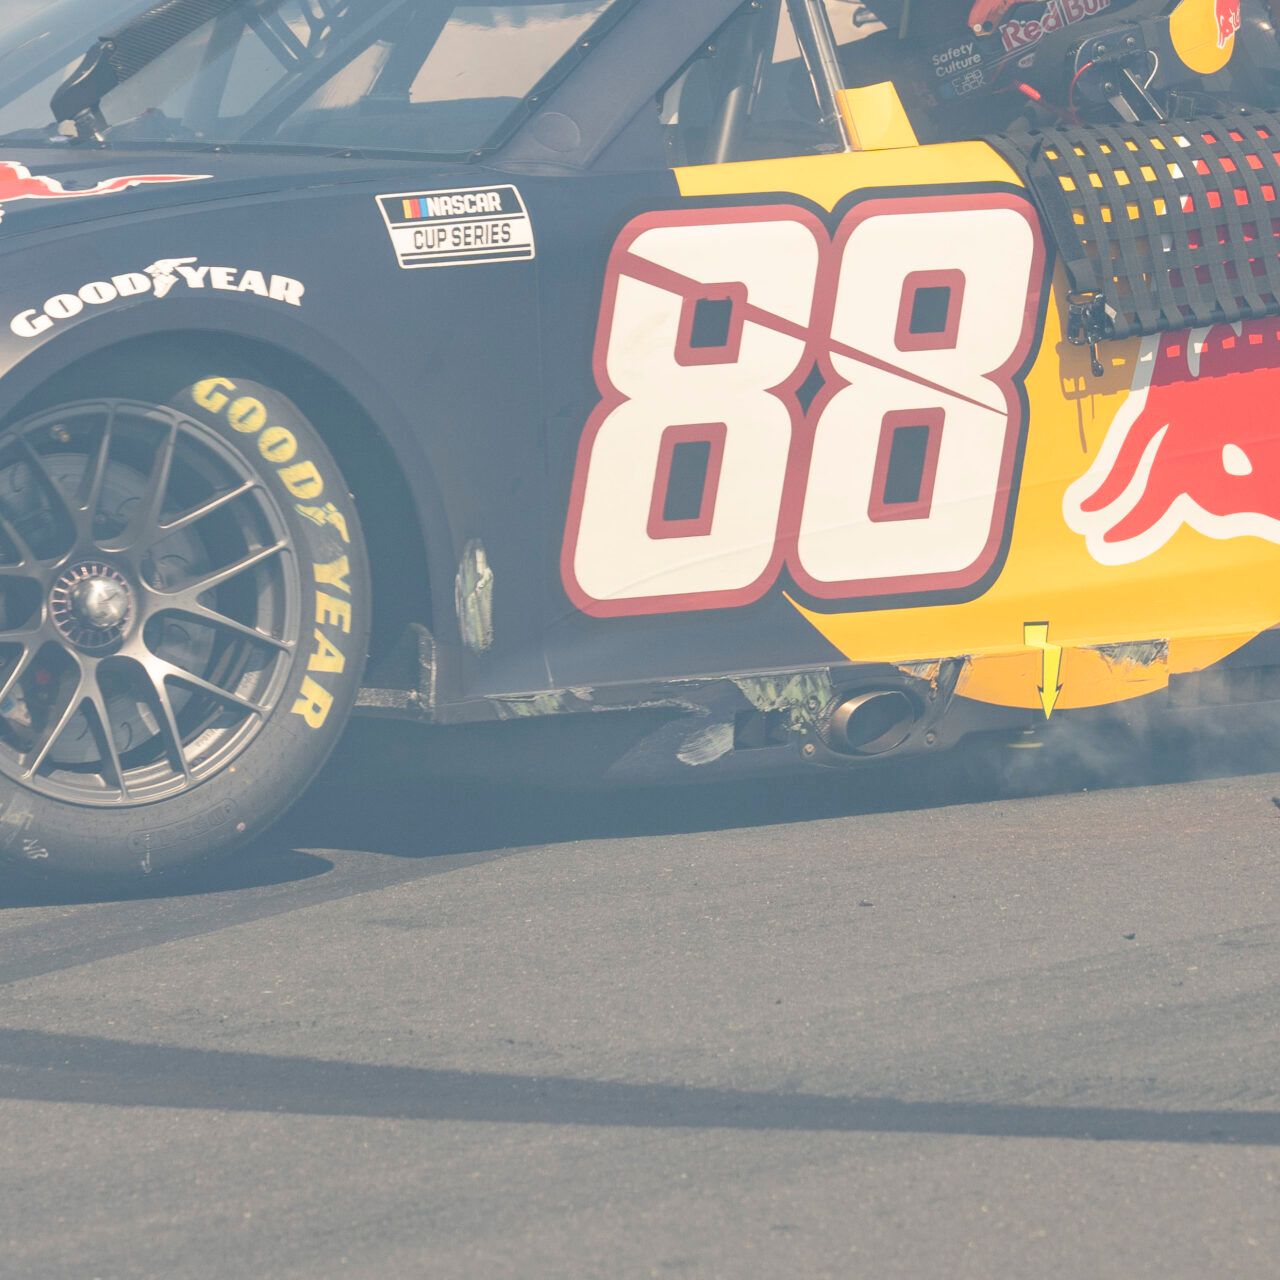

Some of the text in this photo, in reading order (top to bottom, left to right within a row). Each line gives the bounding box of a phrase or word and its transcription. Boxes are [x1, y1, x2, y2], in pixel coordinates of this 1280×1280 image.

[999, 0, 1065, 52] Red
[932, 42, 974, 66] Safety
[936, 54, 981, 77] Culture
[426, 192, 503, 217] NASCAR
[414, 223, 512, 250] CUP SERIES
[10, 257, 305, 338] GOODYEAR
[562, 194, 1044, 616] 88
